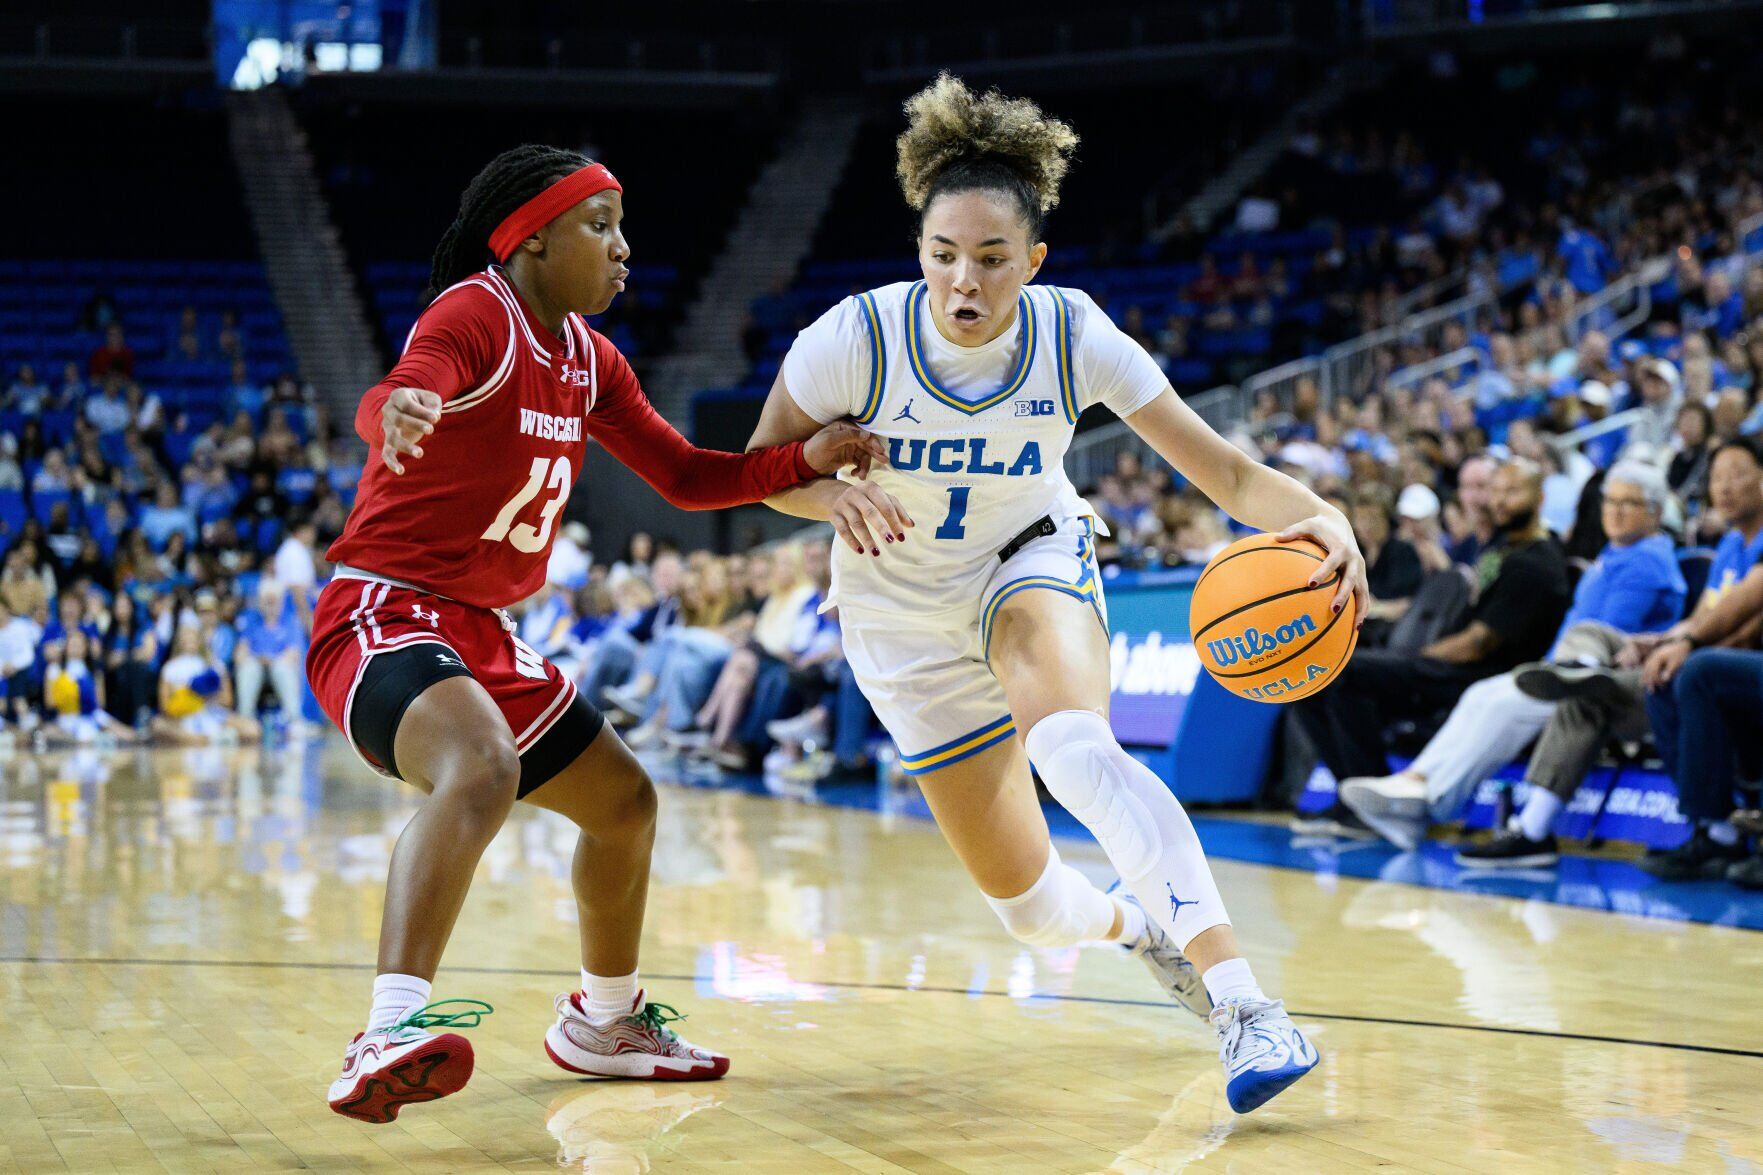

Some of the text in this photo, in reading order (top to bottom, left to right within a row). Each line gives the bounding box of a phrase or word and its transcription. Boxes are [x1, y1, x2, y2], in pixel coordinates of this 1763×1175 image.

[1014, 399, 1056, 417] BIG
[888, 437, 1043, 476] UCLA
[480, 456, 572, 554] 13
[935, 486, 973, 540] 1
[1206, 613, 1318, 668] Wilson
[1243, 664, 1330, 699] UCLA
